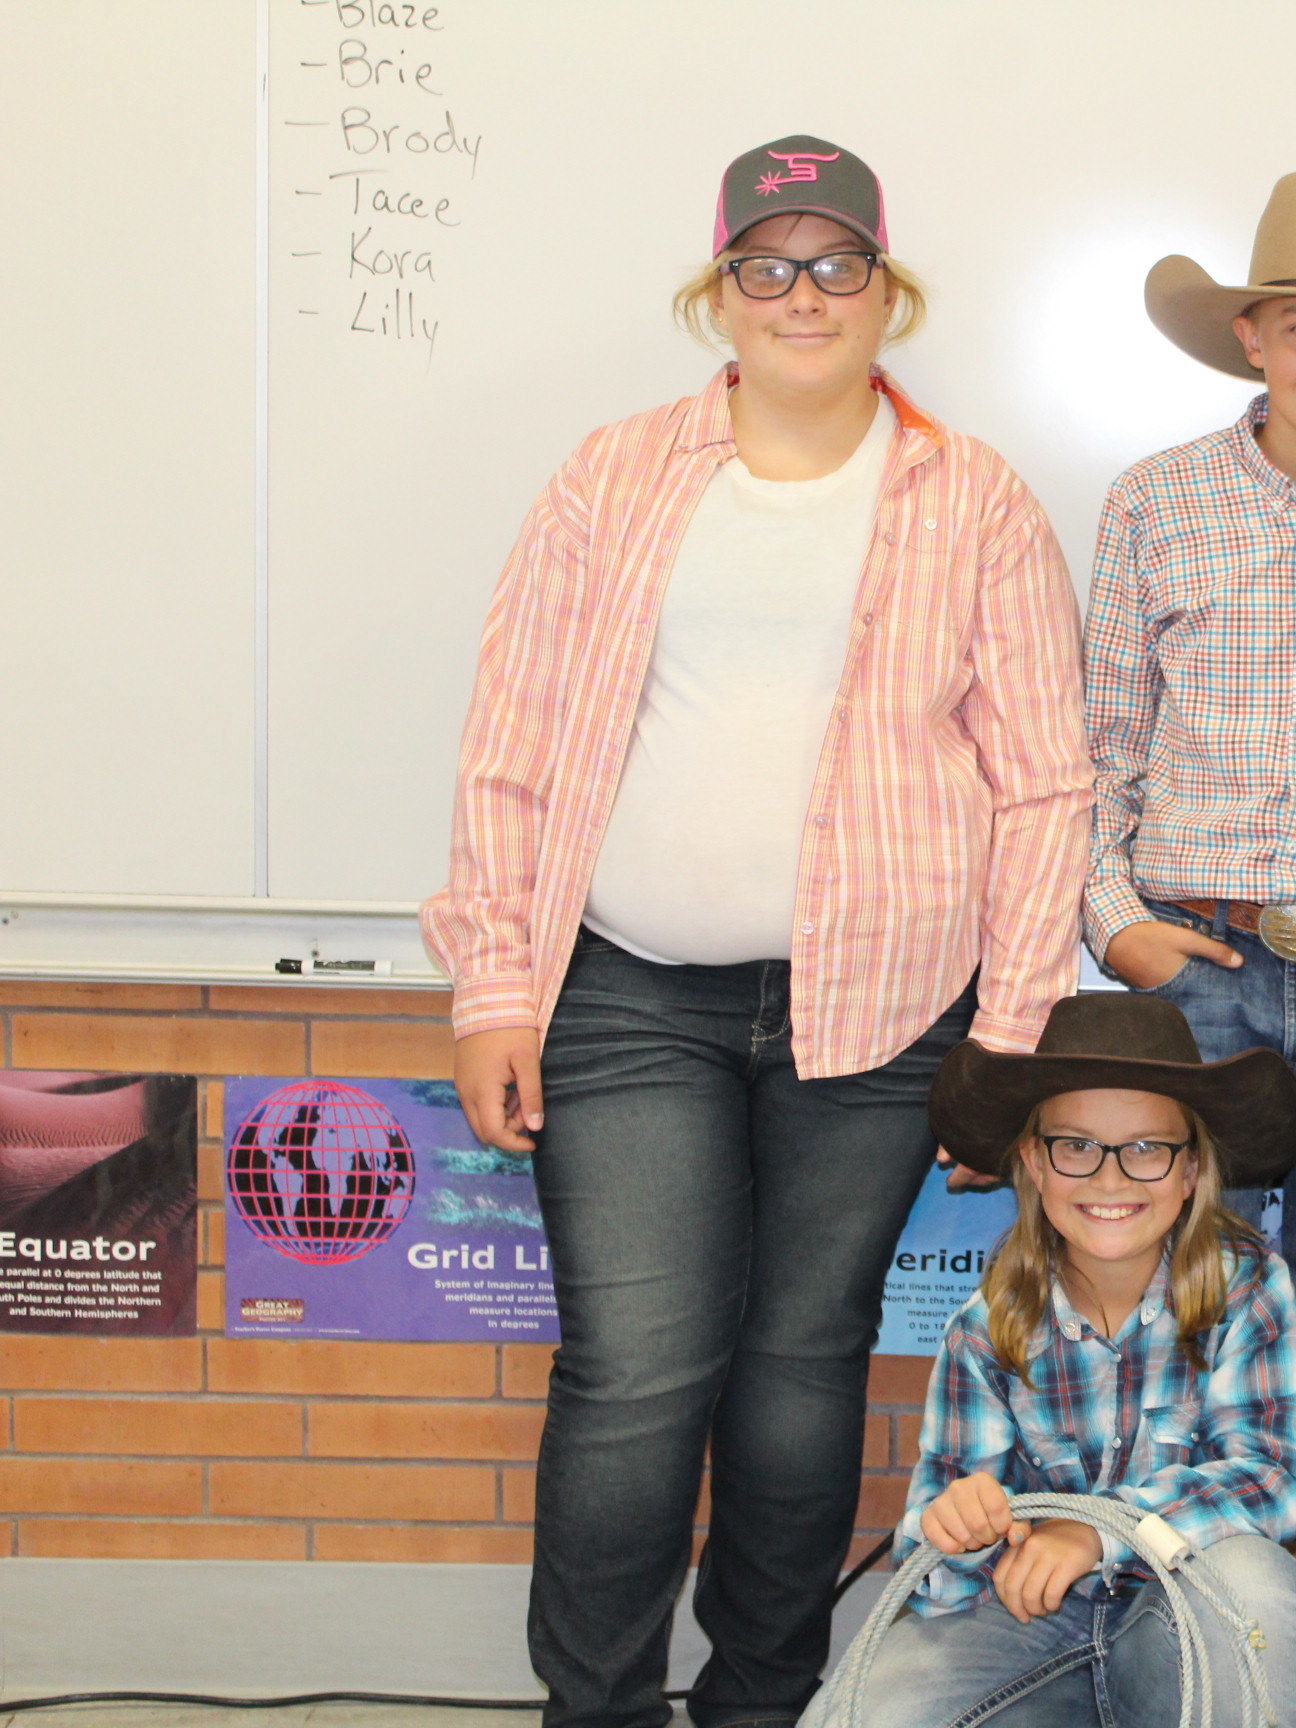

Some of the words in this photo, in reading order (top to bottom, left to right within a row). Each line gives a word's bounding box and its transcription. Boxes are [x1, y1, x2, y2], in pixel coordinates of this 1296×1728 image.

[337, 0, 444, 30] Blaze
[339, 39, 442, 95] Brie
[342, 107, 481, 180] Brody
[330, 169, 461, 226] Tacee
[350, 227, 435, 282] Kora
[351, 288, 438, 367] Lilly
[0, 1232, 156, 1262] Equator
[407, 1242, 495, 1270] Grid
[515, 1245, 548, 1271] Li
[896, 1249, 986, 1274] eridi
[7, 1268, 40, 1278] parallel
[42, 1269, 52, 1277] at
[55, 1269, 61, 1277] 0
[64, 1269, 101, 1280] degrees
[104, 1270, 140, 1280] latitude
[142, 1270, 162, 1280] that
[0, 1281, 24, 1292] equal
[27, 1281, 64, 1291] distance
[67, 1282, 89, 1292] from
[92, 1283, 108, 1292] the
[111, 1283, 139, 1292] North
[142, 1284, 160, 1293] and
[435, 1280, 470, 1290] System
[474, 1280, 484, 1289] of
[487, 1281, 534, 1291] imaginary
[538, 1282, 554, 1290] line
[909, 1283, 930, 1291] lines
[935, 1284, 954, 1292] that
[0, 1294, 15, 1302] uth
[17, 1294, 42, 1304] Poles
[45, 1295, 61, 1304] and
[64, 1296, 96, 1305] divides
[99, 1297, 115, 1305] the
[118, 1297, 161, 1306] Northern
[445, 1293, 493, 1302] meridians
[496, 1294, 514, 1302] and
[883, 1295, 911, 1303] North
[256, 1301, 289, 1309] GREAT
[9, 1307, 27, 1316] and
[30, 1307, 71, 1318] Southern
[74, 1308, 139, 1319] Hemispheres
[242, 1308, 303, 1316] GEOGRAPHY
[469, 1307, 511, 1315] measure
[514, 1307, 558, 1316] locations
[907, 1309, 948, 1317] measure
[488, 1320, 498, 1328] in
[501, 1320, 539, 1329] degrees
